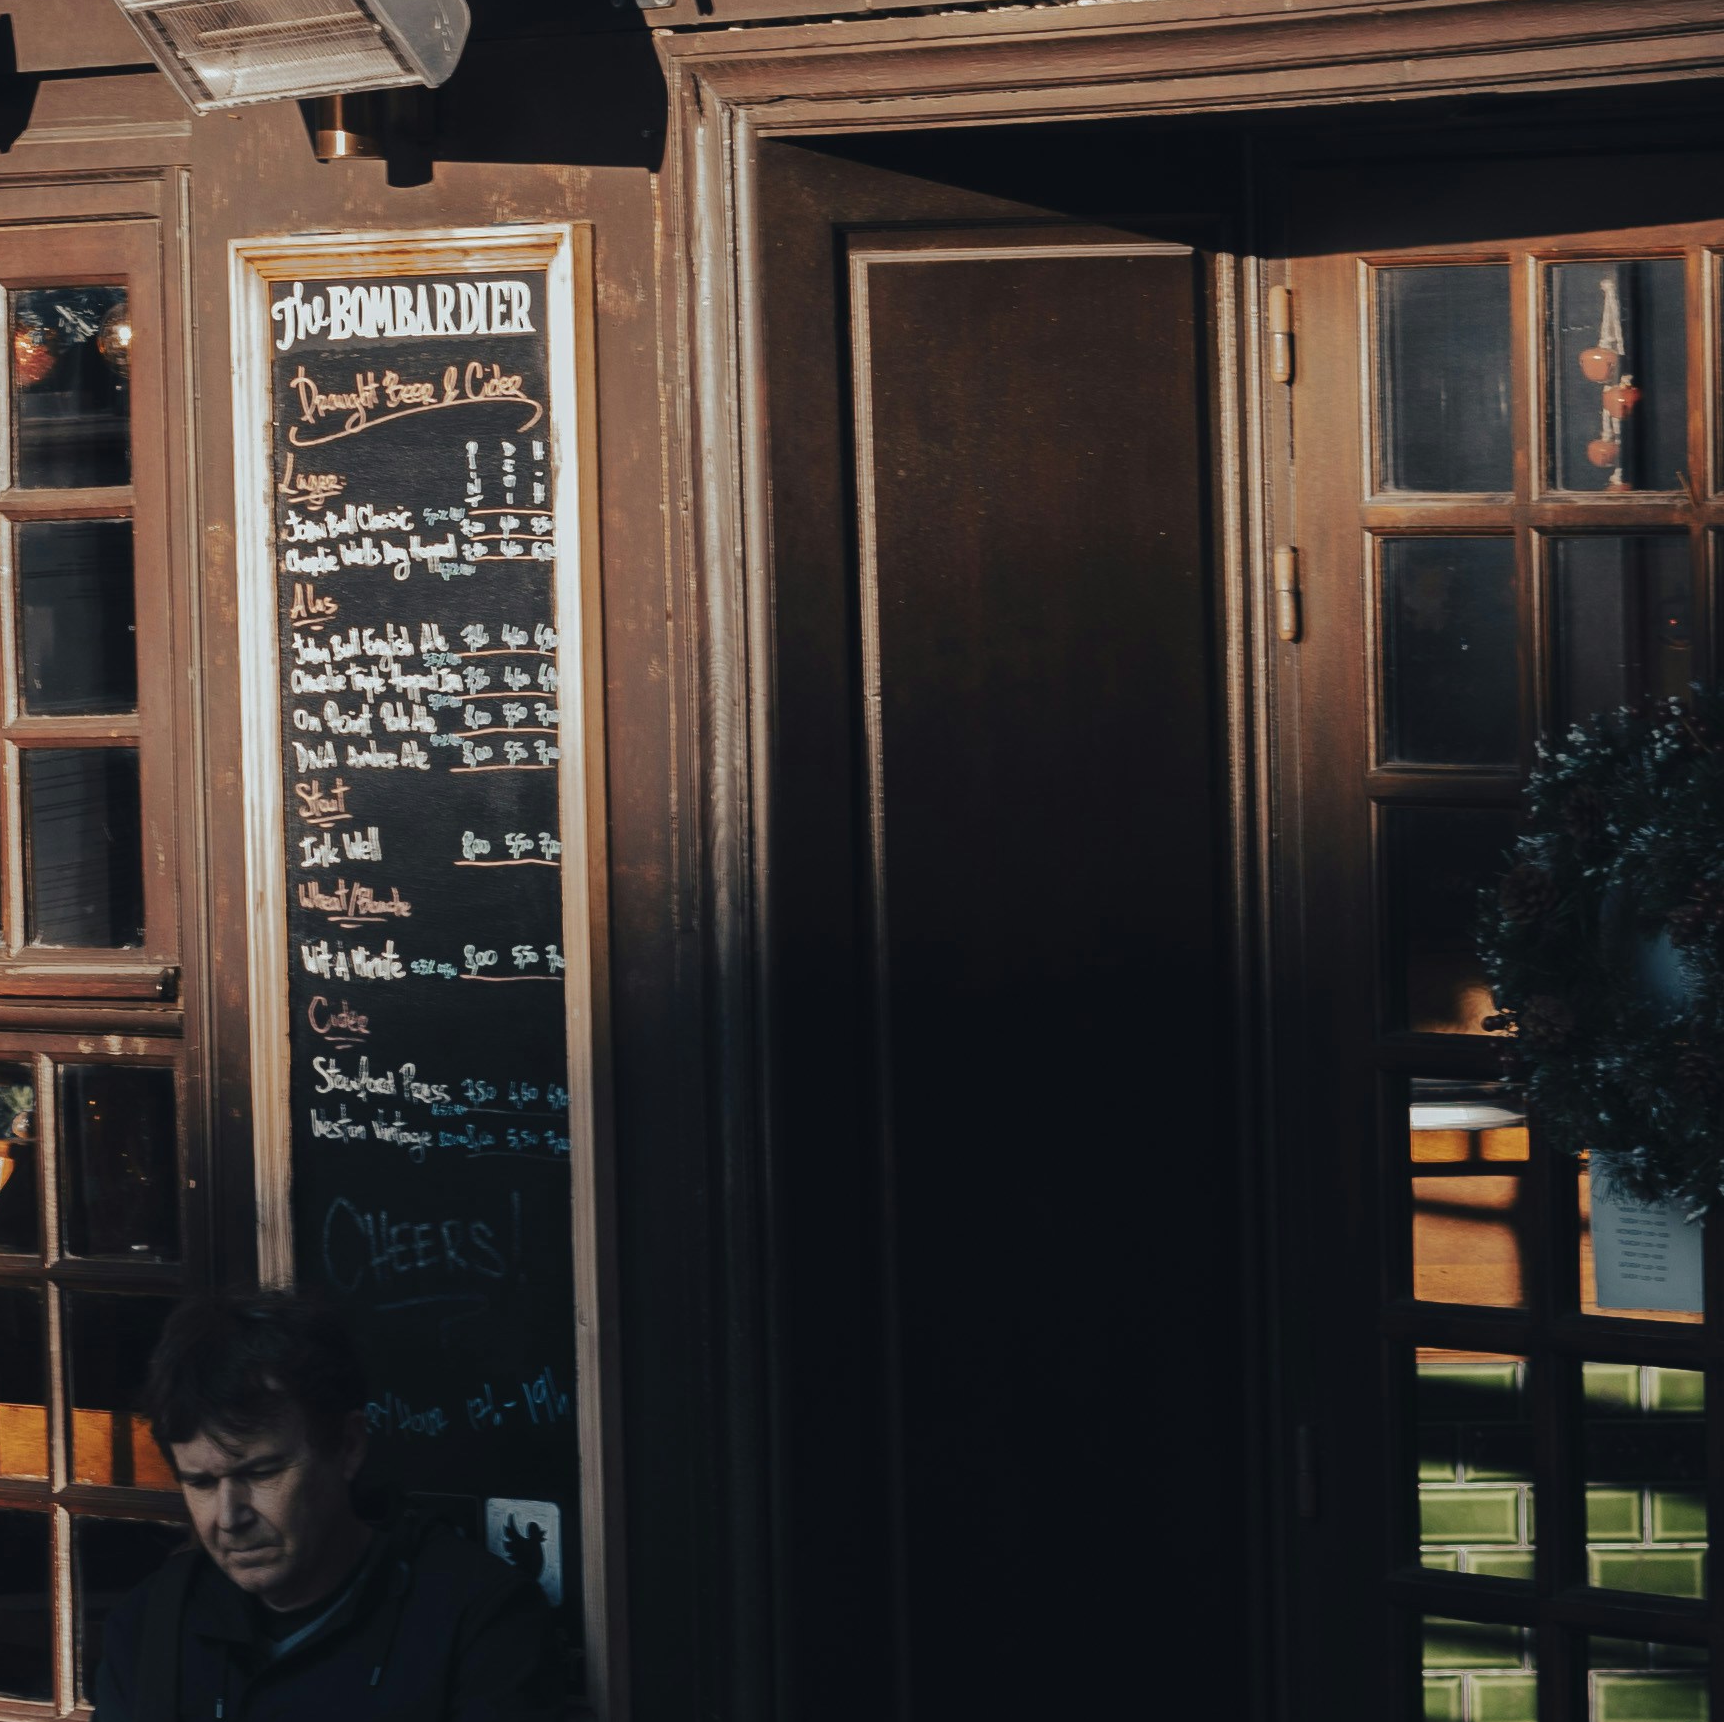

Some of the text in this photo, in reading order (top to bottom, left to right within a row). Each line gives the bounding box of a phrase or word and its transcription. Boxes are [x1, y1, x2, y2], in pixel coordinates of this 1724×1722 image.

[272, 280, 536, 351] The BOMBARDIER
[342, 826, 382, 861] Well
